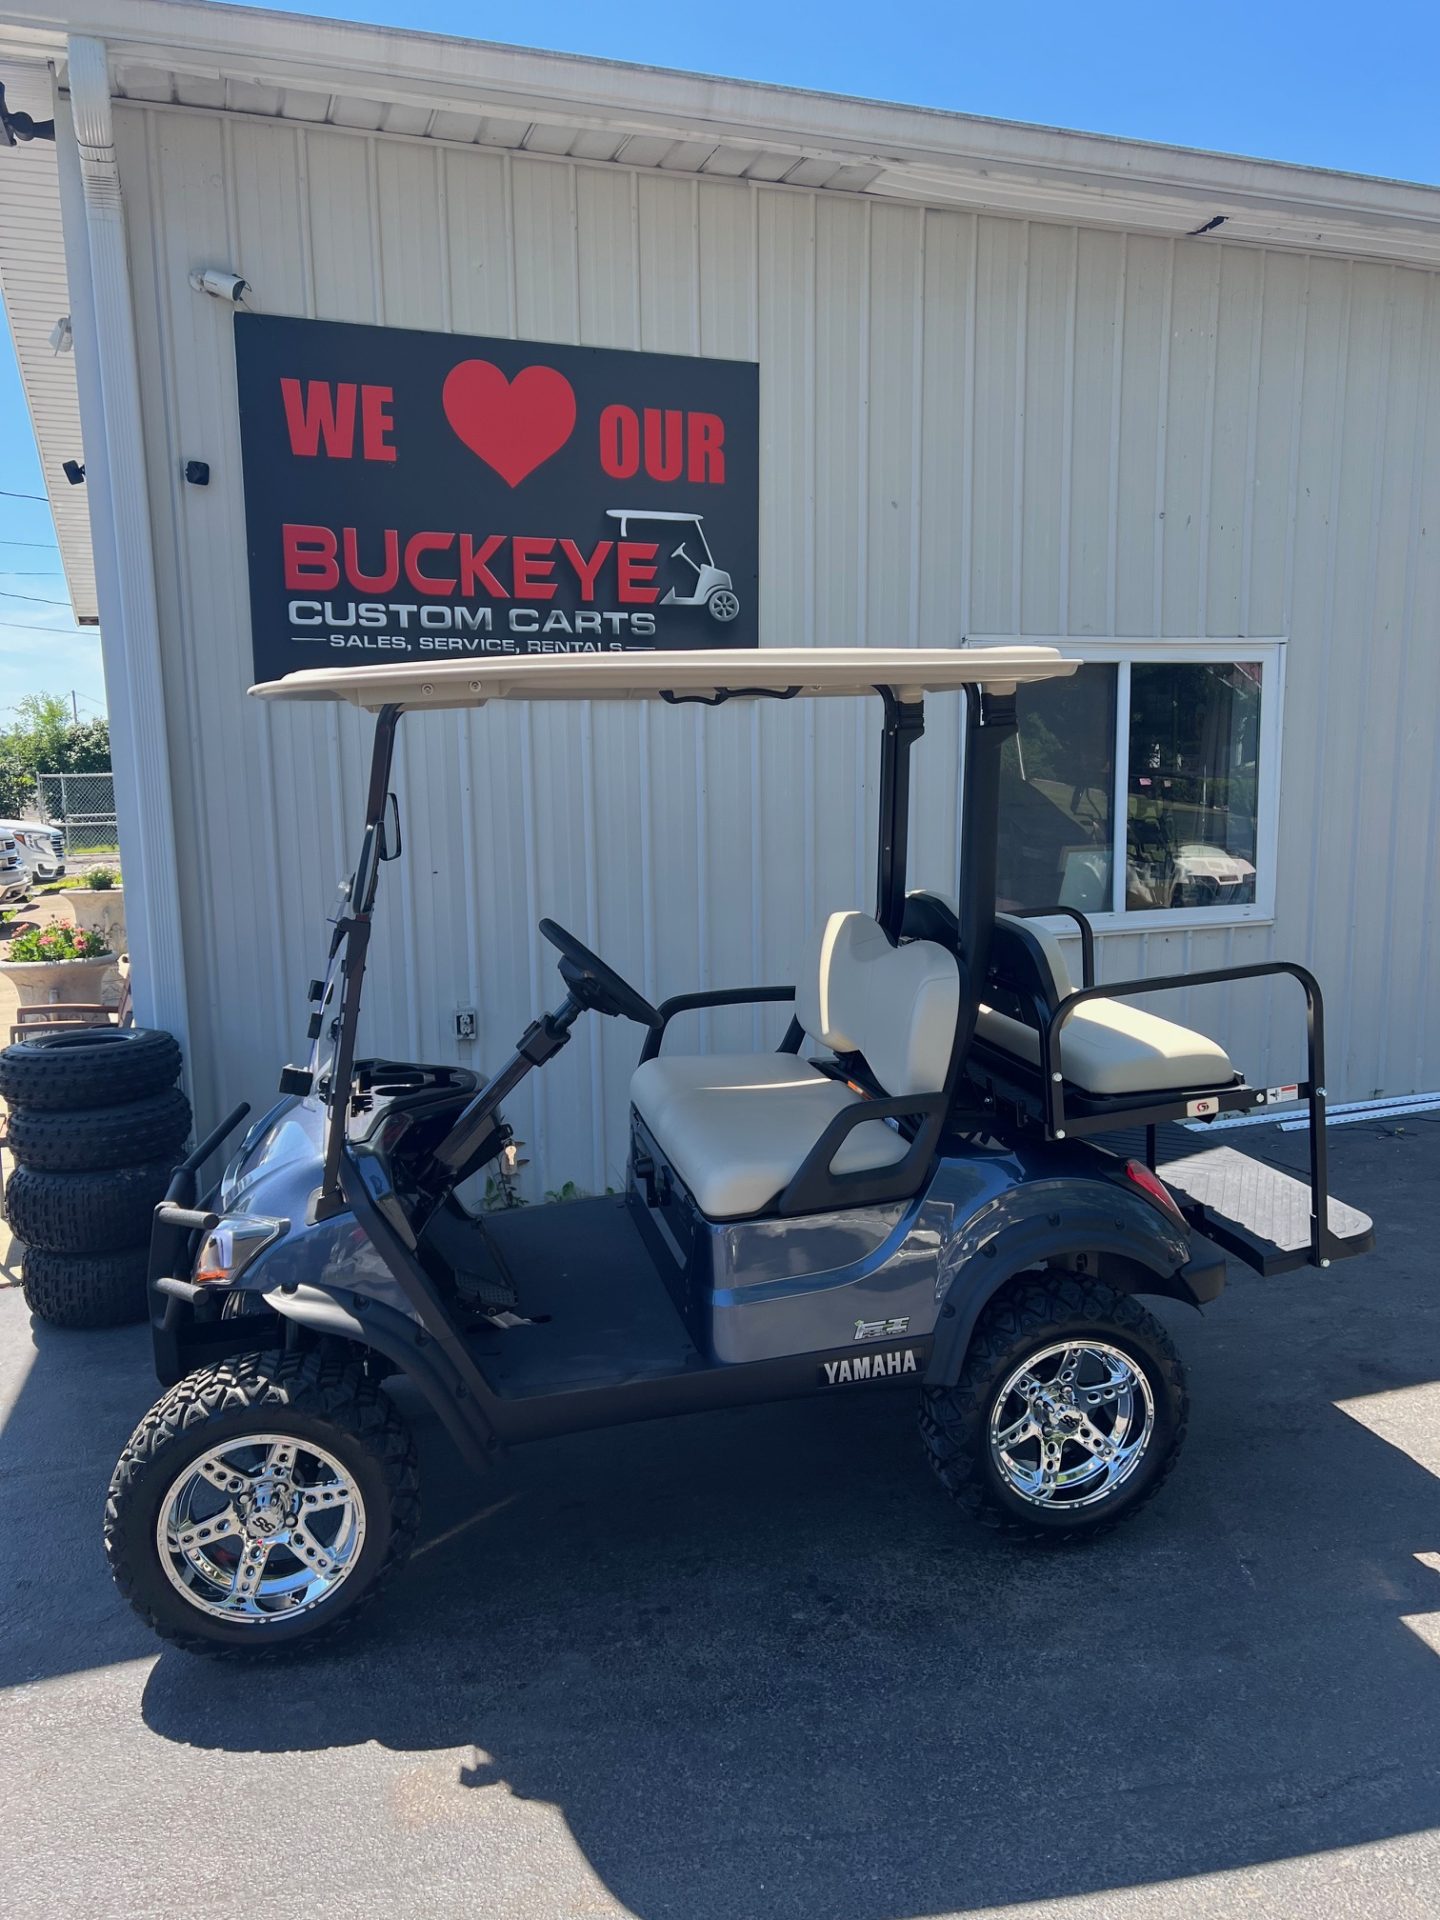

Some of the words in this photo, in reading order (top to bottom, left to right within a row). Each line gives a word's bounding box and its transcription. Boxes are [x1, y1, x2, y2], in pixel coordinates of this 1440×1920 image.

[280, 377, 398, 462] WE
[599, 404, 726, 483] OUR
[282, 523, 660, 604] BUCKEYE
[288, 600, 492, 631] CUSTOM
[508, 608, 656, 636] CARTS
[329, 634, 412, 651] SALES,
[419, 637, 520, 654] SERVICE,
[824, 1350, 917, 1384] YAMAHA
